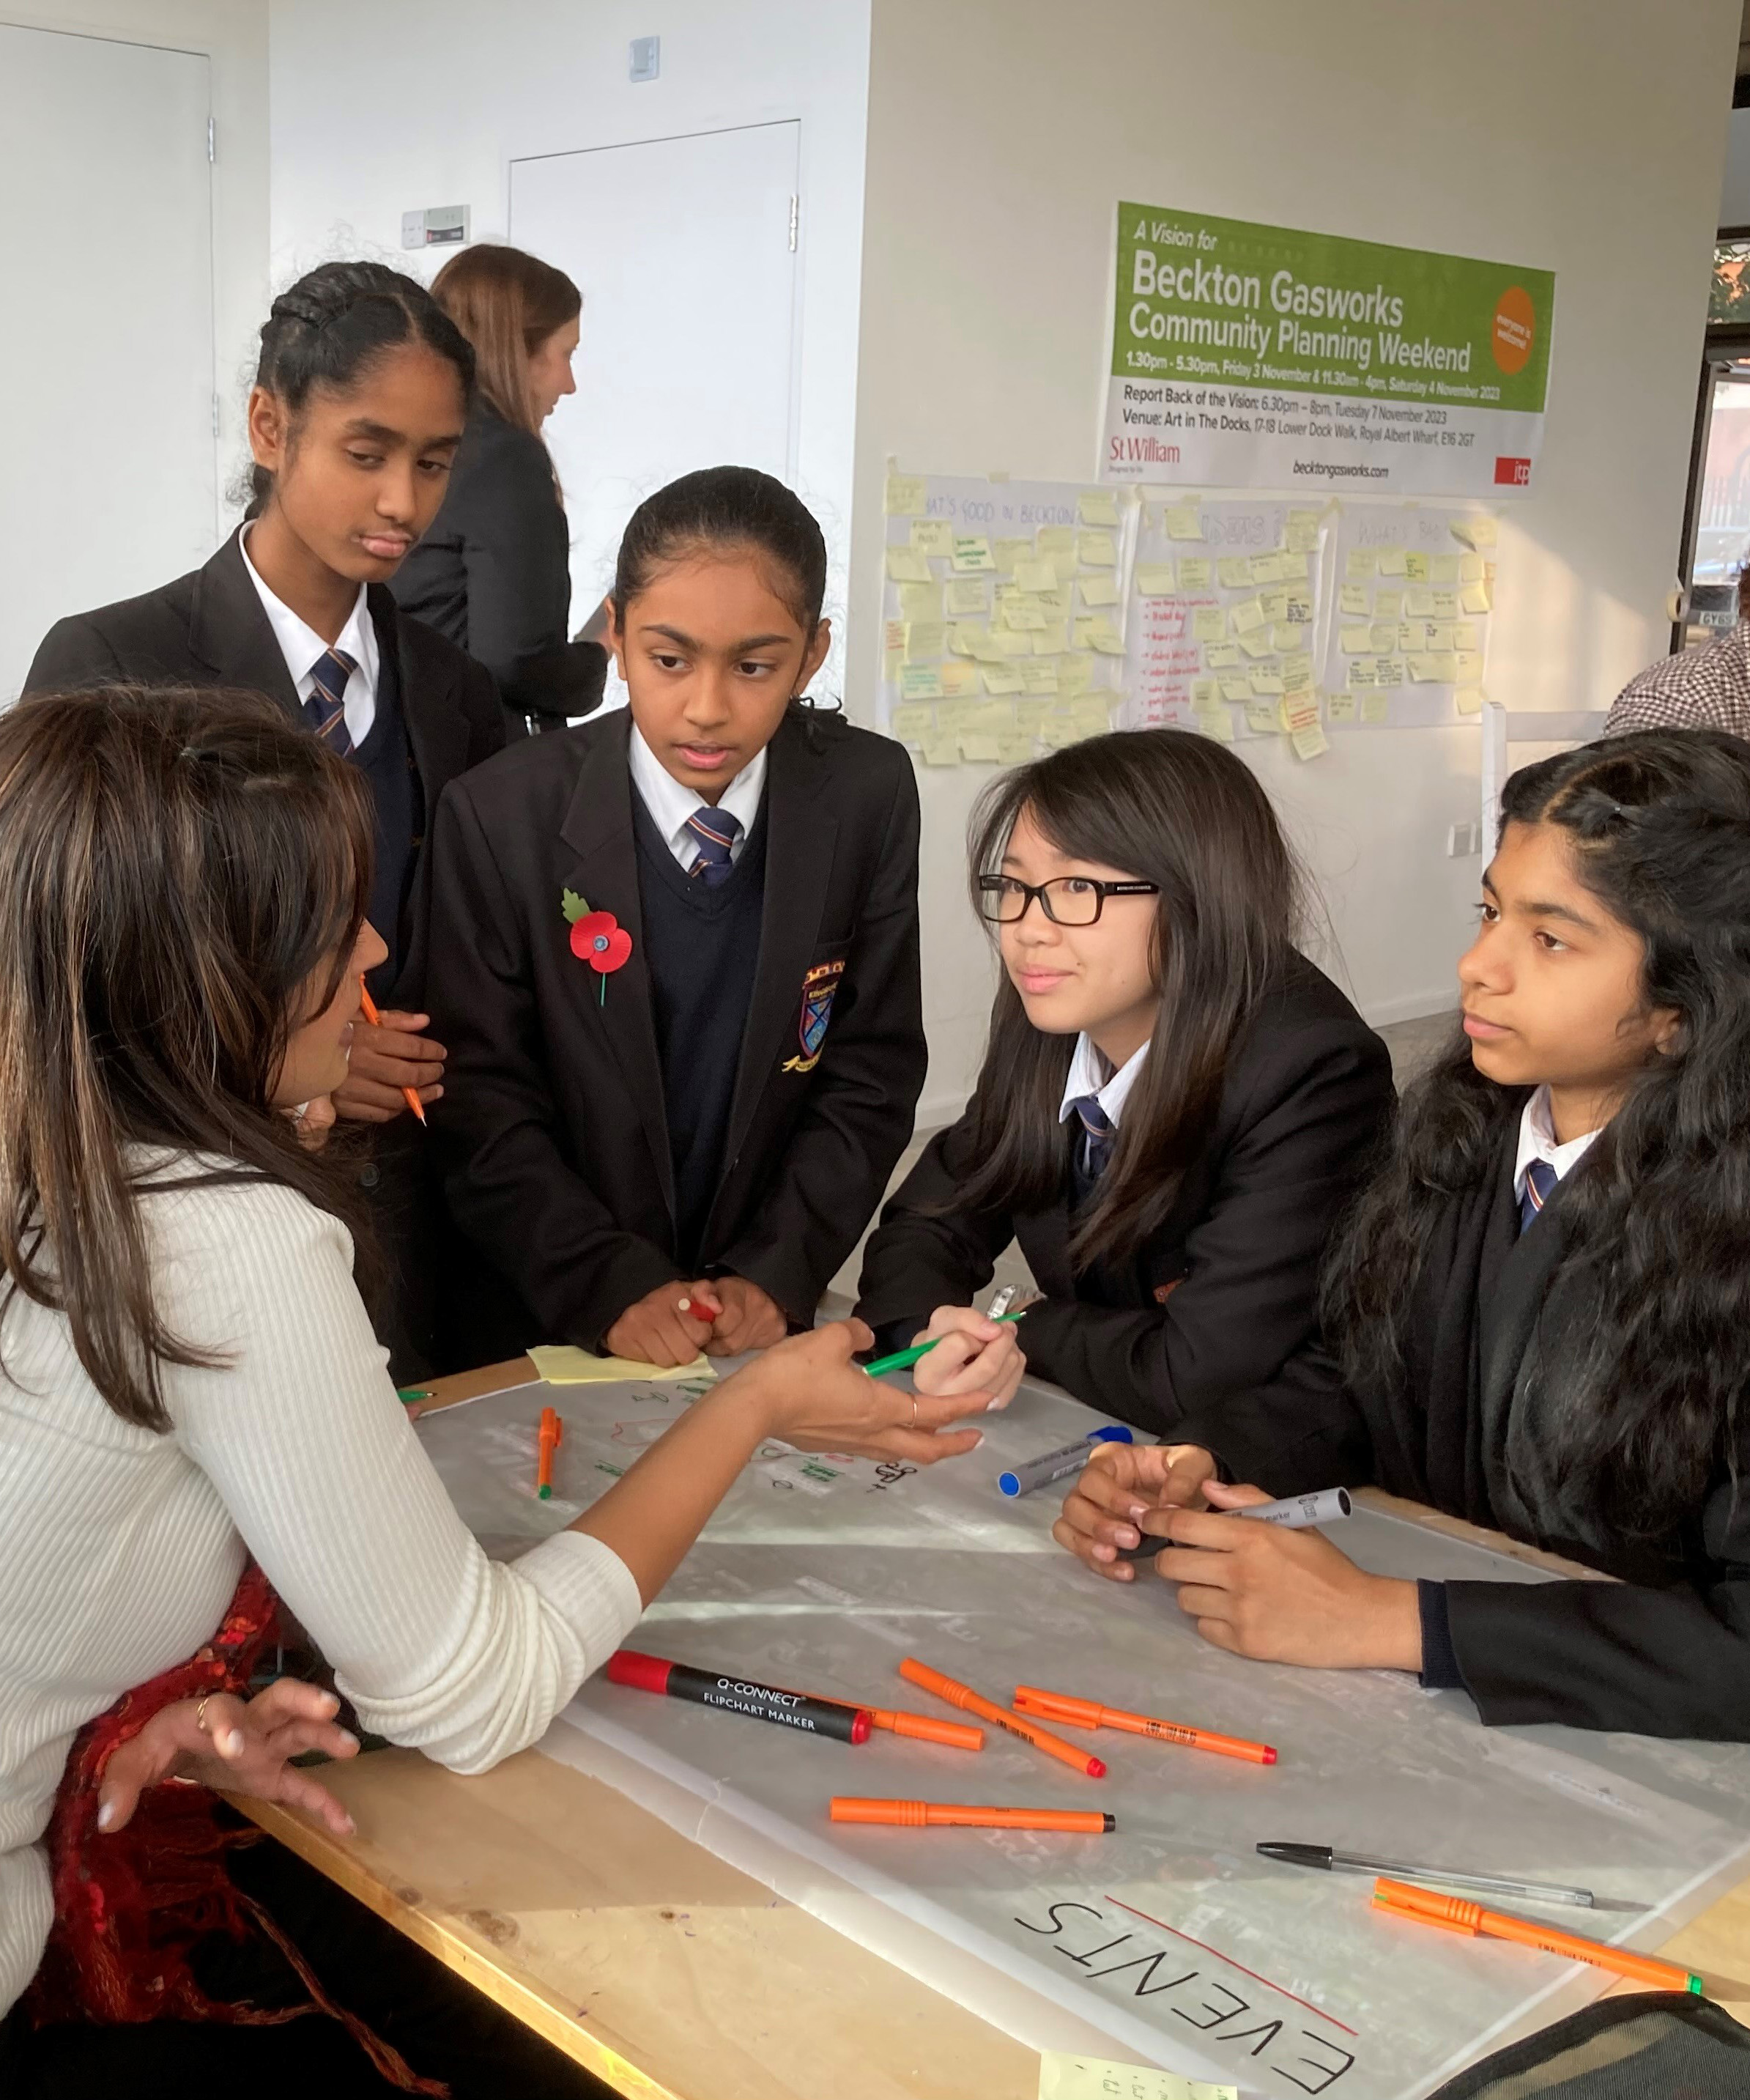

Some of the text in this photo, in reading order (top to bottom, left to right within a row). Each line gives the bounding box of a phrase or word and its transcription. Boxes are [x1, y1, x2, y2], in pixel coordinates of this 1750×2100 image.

[1133, 220, 1217, 251] A Vision for
[1133, 249, 1404, 328] Beckton Gasworks
[1130, 301, 1472, 373] Community Planning Weekend
[1126, 350, 1168, 372] 1.30pm
[1176, 355, 1220, 377] 5.30pm,
[1223, 359, 1252, 381] Friday
[1253, 363, 1261, 378] 3
[1261, 364, 1312, 382] November
[1389, 376, 1428, 398] Saturday
[1429, 380, 1435, 394] 4
[1436, 381, 1479, 399] November
[1124, 384, 1163, 405] Report
[1165, 387, 1193, 404] Back
[1195, 390, 1207, 405] of
[1209, 391, 1226, 407] the
[1228, 391, 1259, 410] Vision:
[1261, 395, 1299, 416] 6.30pm
[1310, 399, 1332, 418] 8pm,
[1335, 401, 1371, 422] Tuesday
[1371, 404, 1379, 420] 7
[1378, 404, 1423, 423] November
[1425, 410, 1447, 425] 2023
[1122, 407, 1476, 447] Venue: Art in The Docks, 17-18 Lower Dock Walk, Royal Albert Wharf, E16 2GT
[1109, 435, 1181, 464] St William
[1293, 457, 1390, 480] becktongasworks.com
[1020, 503, 1075, 525] BECKTON
[1265, 1511, 1291, 1523] marker
[703, 1692, 816, 1731] FLIPCHART MARKER
[716, 1677, 803, 1708] Q-CONNECT
[1014, 1901, 1356, 2096] EVENTS
